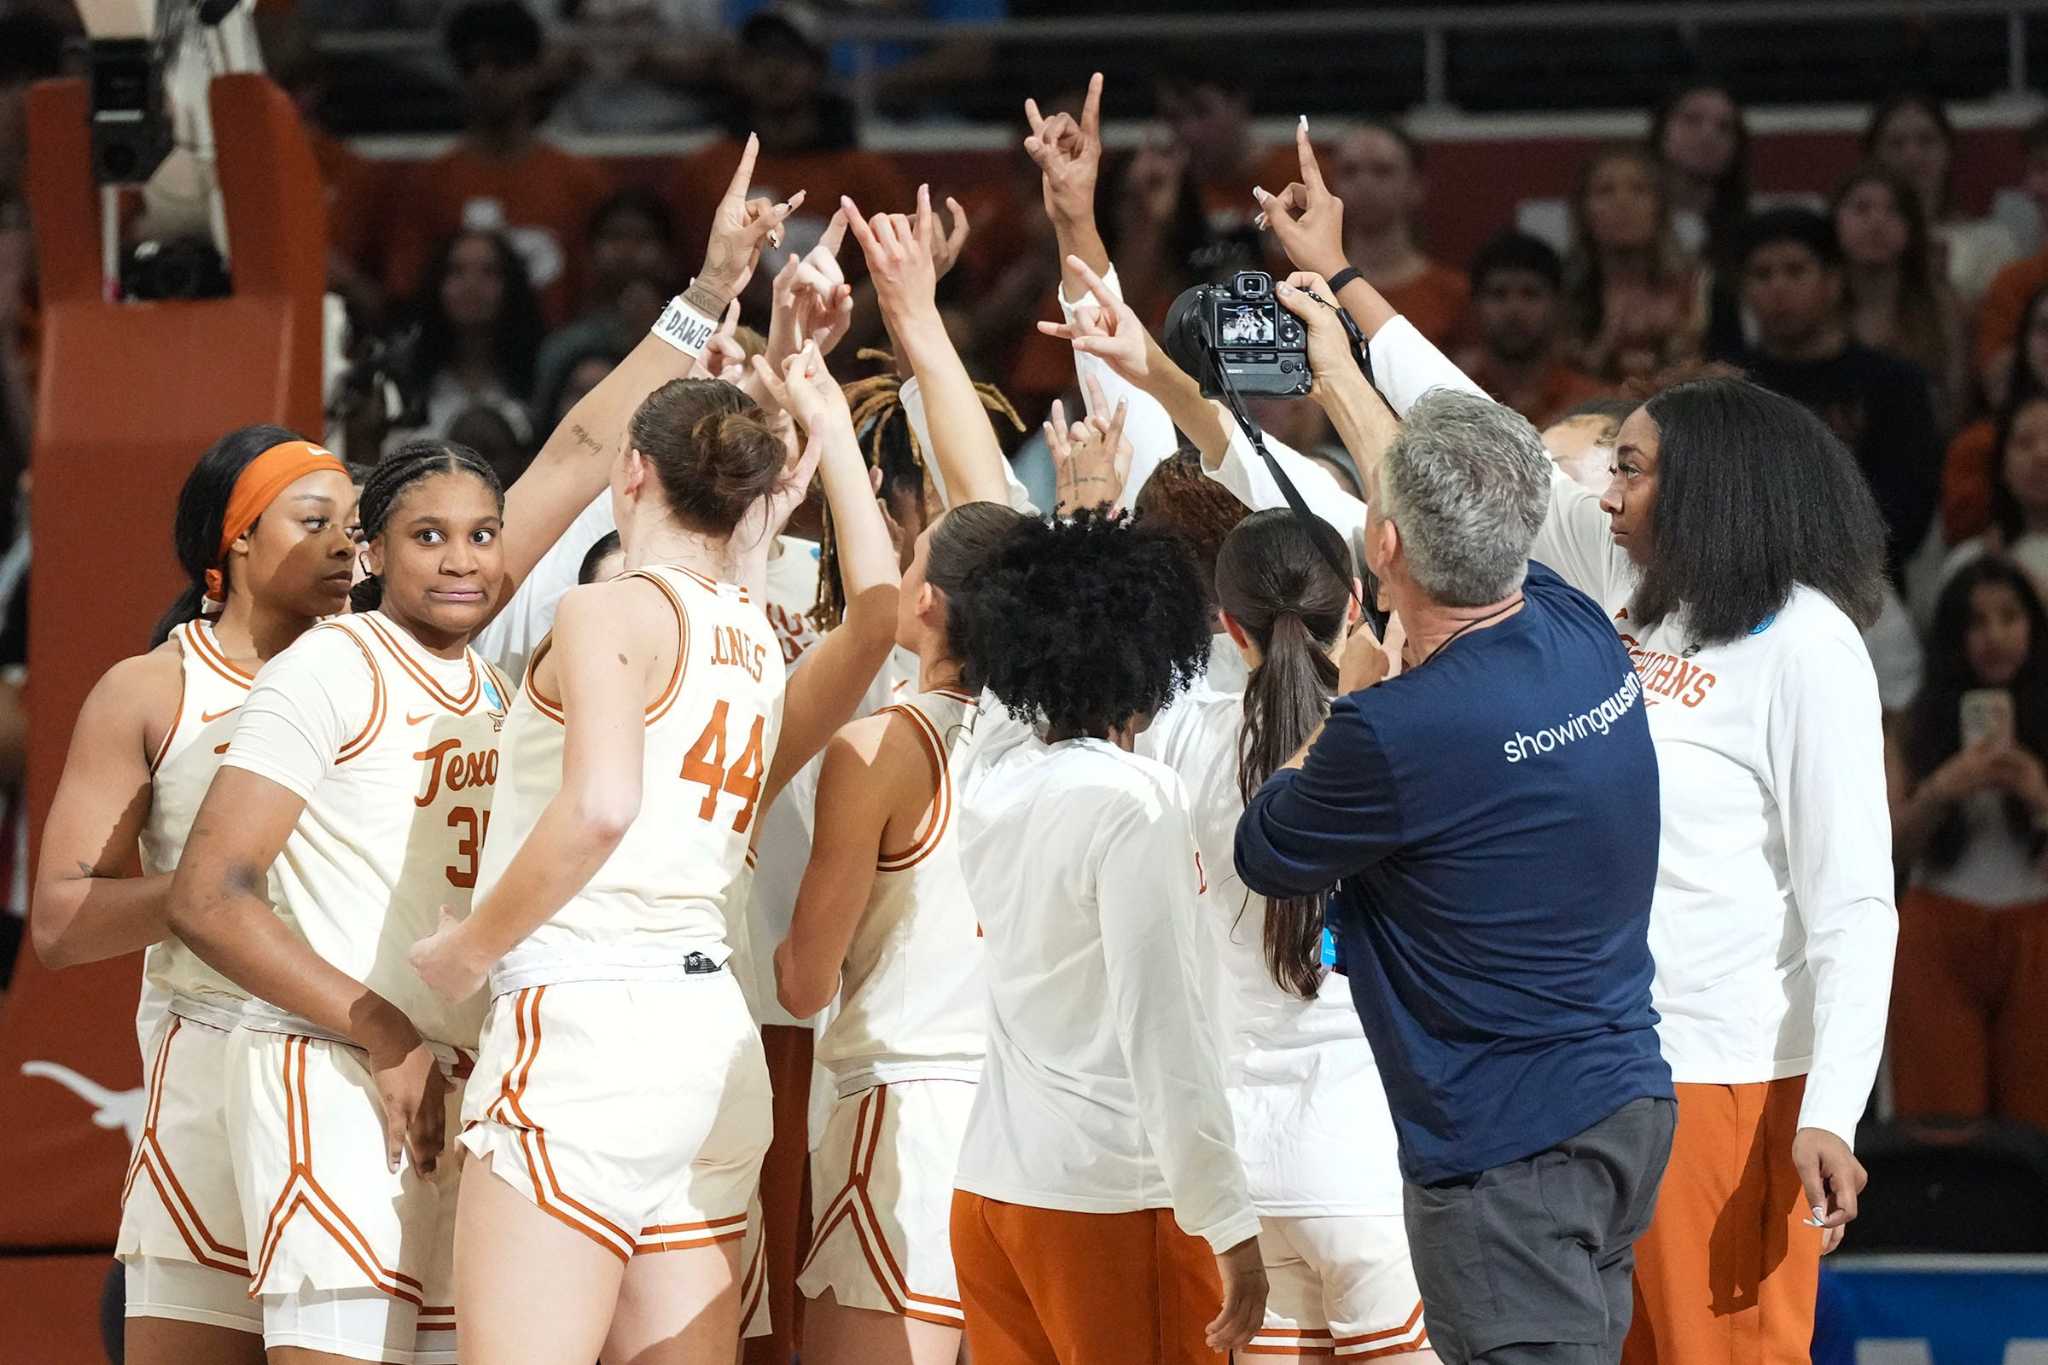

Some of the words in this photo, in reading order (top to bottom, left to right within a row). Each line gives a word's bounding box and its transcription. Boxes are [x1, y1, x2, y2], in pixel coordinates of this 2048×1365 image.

[665, 310, 712, 350] DAWG
[412, 738, 499, 808] Texa
[679, 698, 766, 834] 44
